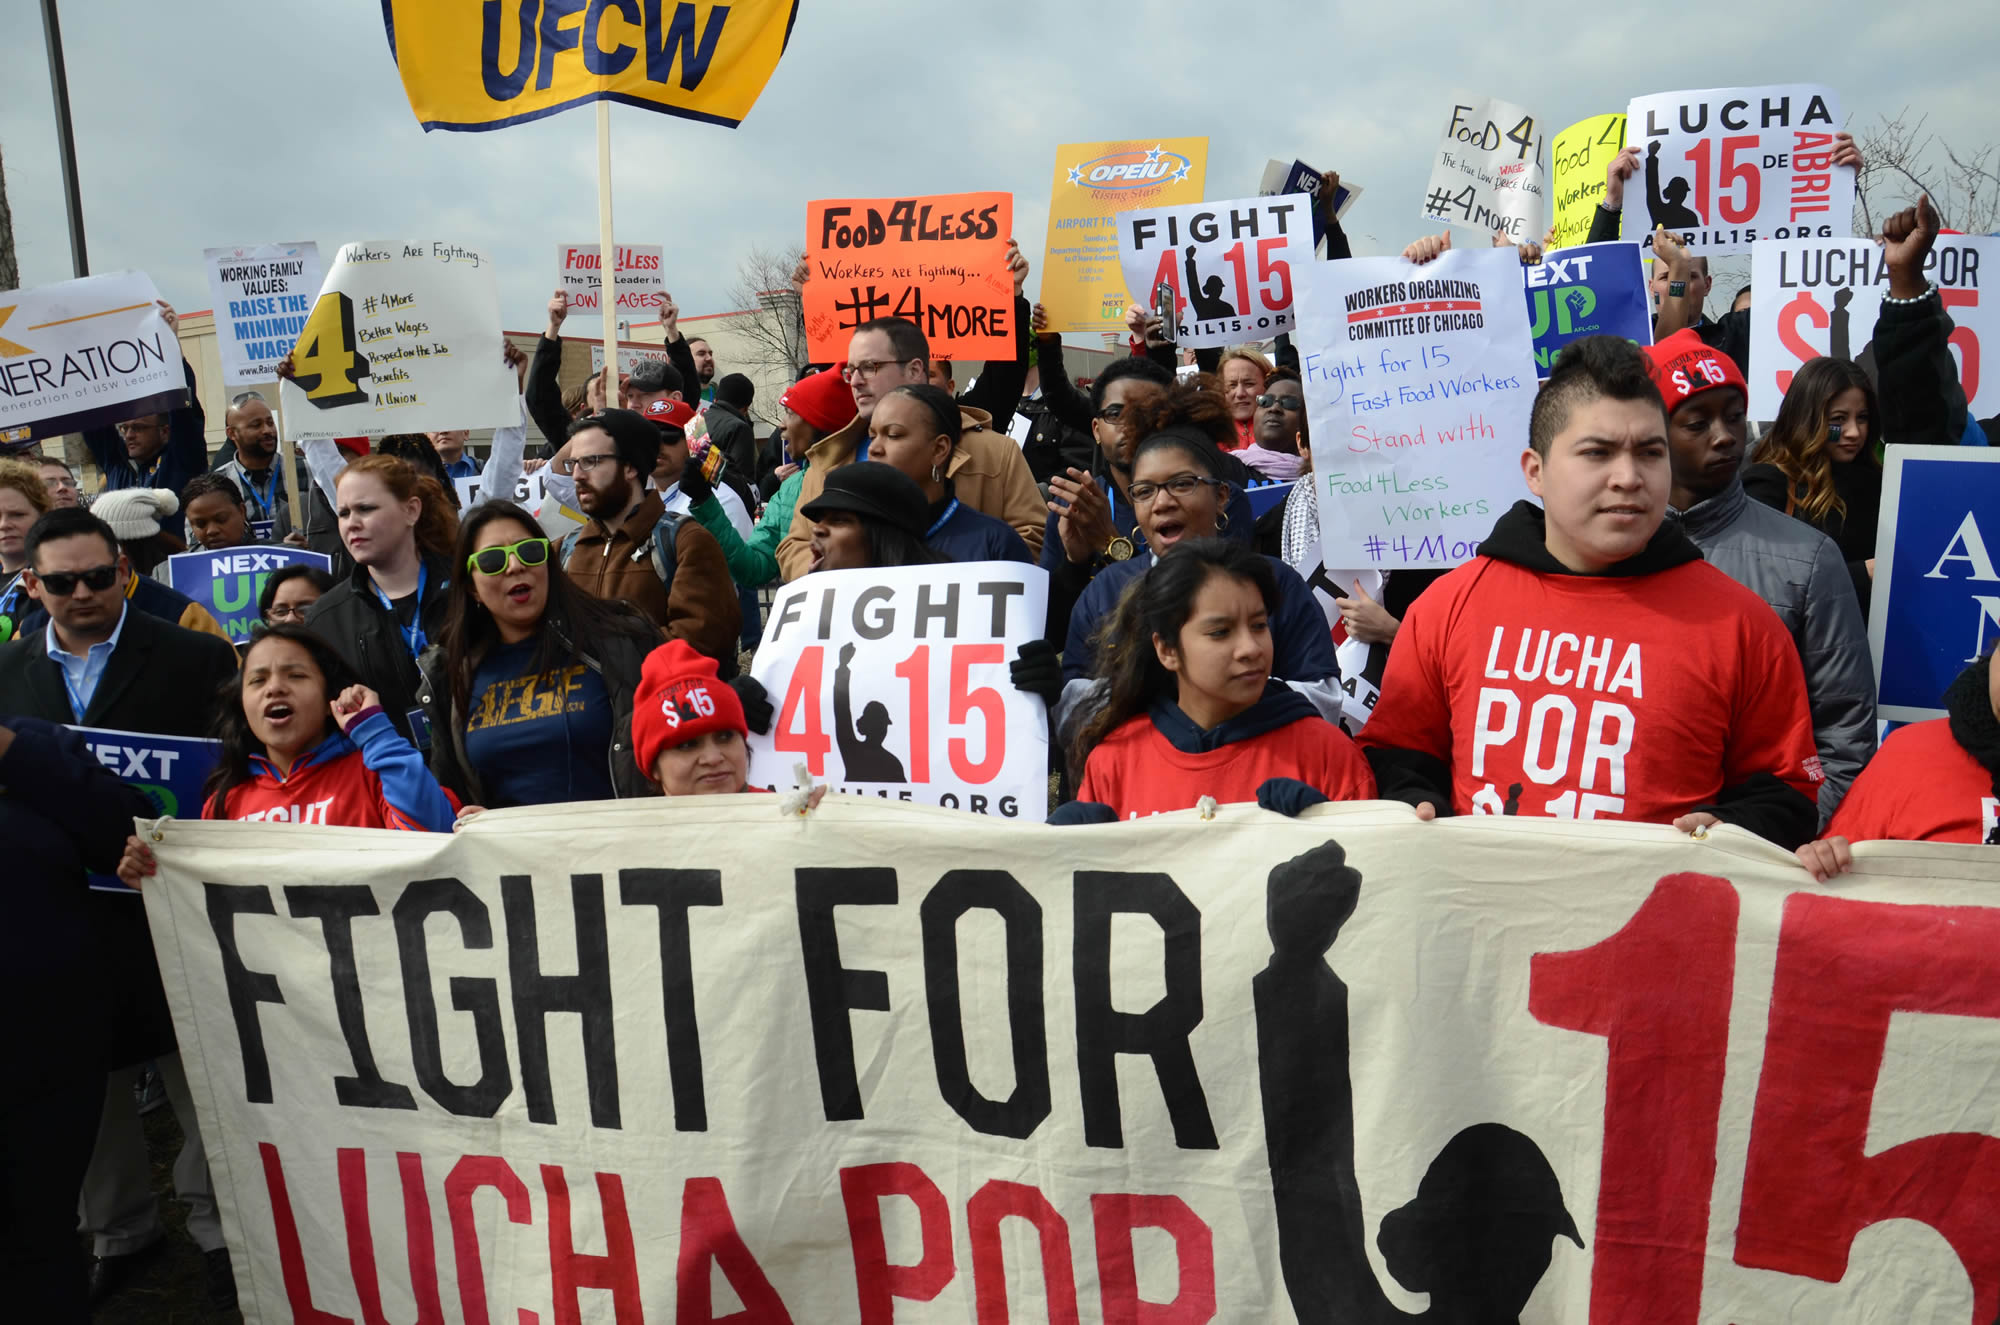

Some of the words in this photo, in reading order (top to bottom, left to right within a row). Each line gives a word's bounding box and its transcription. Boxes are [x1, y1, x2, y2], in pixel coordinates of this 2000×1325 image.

[481, 0, 731, 101] UFCW
[1647, 95, 1833, 137] LUCHA
[1089, 161, 1172, 182] OPEIU
[1297, 171, 1322, 197] NEX
[1499, 162, 1525, 177] WAGE
[1685, 135, 1761, 226] 15
[1763, 154, 1788, 169] DE
[1789, 131, 1833, 223] ABRIL
[1091, 189, 1127, 200] Rising
[1130, 186, 1161, 199] Stars
[1557, 181, 1607, 212] WORKER
[1056, 217, 1099, 230] AIRPORT
[1133, 204, 1295, 250] FIGHT
[1643, 225, 1832, 249] ARIL15.ORG
[403, 245, 424, 258] ARE
[220, 264, 267, 282] WORKING
[269, 261, 303, 277] FAMILY
[564, 276, 584, 284] The
[588, 276, 603, 284] Tru
[615, 276, 650, 284] Leader
[652, 276, 661, 284] in
[1224, 237, 1294, 316] 15
[1521, 255, 1592, 289] EXT
[242, 279, 289, 296] VALUES:
[616, 292, 663, 308] AGES
[1345, 281, 1407, 312] WORKERS
[1409, 279, 1481, 301] ORGANIZING
[229, 297, 276, 318] RAISE
[278, 294, 308, 313] THE
[1102, 307, 1124, 319] UP
[1348, 317, 1415, 341] COMMITTEE
[1417, 315, 1431, 334] OF
[1433, 313, 1484, 332] CHICAGO
[1574, 324, 1600, 333] AFL-CIO
[75, 386, 88, 397] of
[94, 382, 119, 392] USW
[125, 370, 169, 387] Leaders
[1306, 353, 1366, 405] Fight
[1379, 348, 1411, 374] for
[1422, 345, 1450, 369] 15
[1352, 390, 1393, 415] Fast
[1399, 383, 1435, 405] Food
[1439, 373, 1520, 399] Workers
[1348, 424, 1426, 453] Stand
[1438, 413, 1495, 445] with
[1382, 499, 1489, 526] Workers
[1363, 533, 1479, 563] #4Mor
[211, 553, 290, 577] NEXT
[772, 581, 1025, 643] FIGHT
[1484, 625, 1643, 699] LUCHA
[774, 646, 831, 777] 4
[895, 643, 1005, 785] 15
[1472, 687, 1636, 795] POR
[87, 743, 179, 780] EXT
[203, 867, 723, 1133] FIGHT
[793, 865, 1221, 1150] FOR
[1528, 871, 2000, 1325] 15
[258, 1143, 795, 1325] LUCHA
